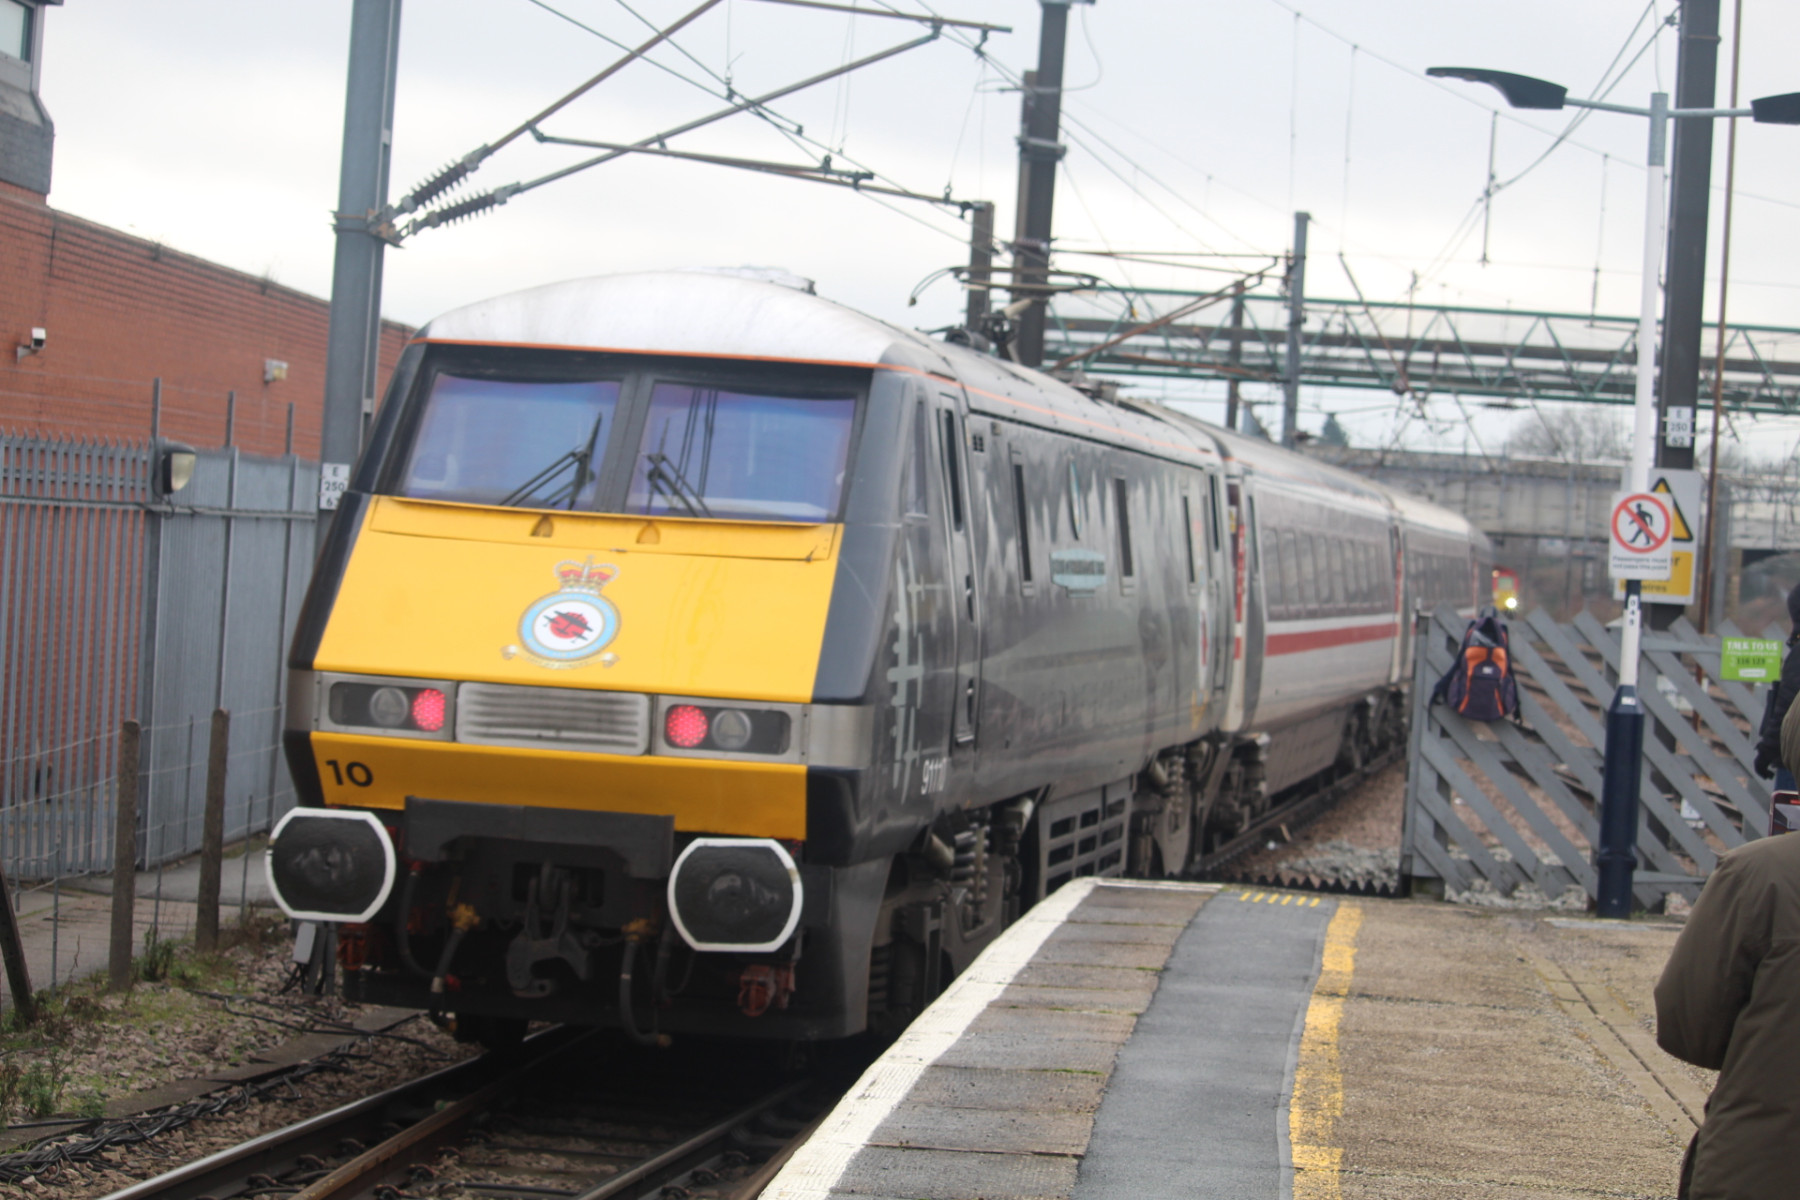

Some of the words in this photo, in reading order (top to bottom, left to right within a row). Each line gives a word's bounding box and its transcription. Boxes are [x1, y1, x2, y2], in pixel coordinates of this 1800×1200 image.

[332, 466, 339, 477] E
[324, 481, 345, 492] 250
[1727, 641, 1749, 650] TALK
[1752, 642, 1764, 650] TO
[1766, 642, 1778, 650] US
[325, 759, 374, 787] 10
